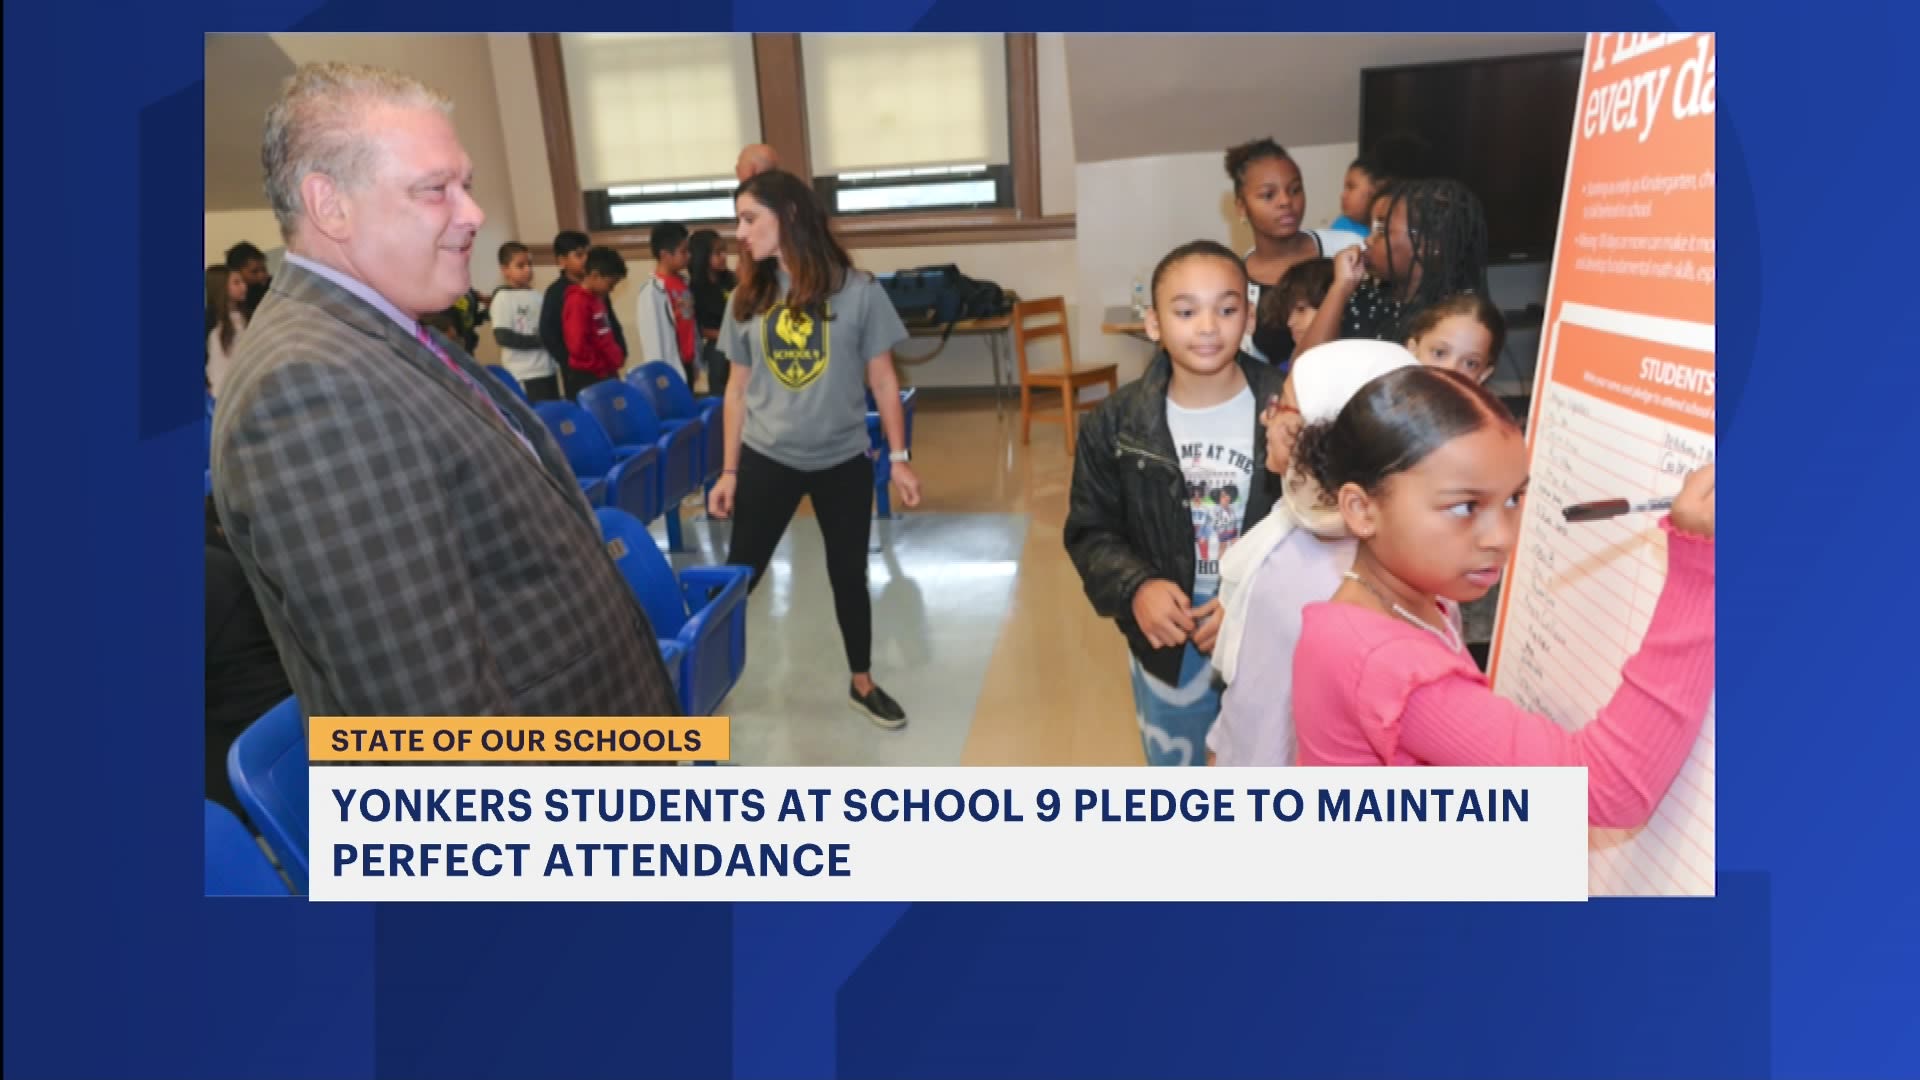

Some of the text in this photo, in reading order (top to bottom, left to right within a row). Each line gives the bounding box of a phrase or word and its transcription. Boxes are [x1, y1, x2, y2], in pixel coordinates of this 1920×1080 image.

[1583, 64, 1671, 143] every
[1639, 356, 1715, 397] STUDENTS
[1181, 442, 1254, 475] ME AT THE
